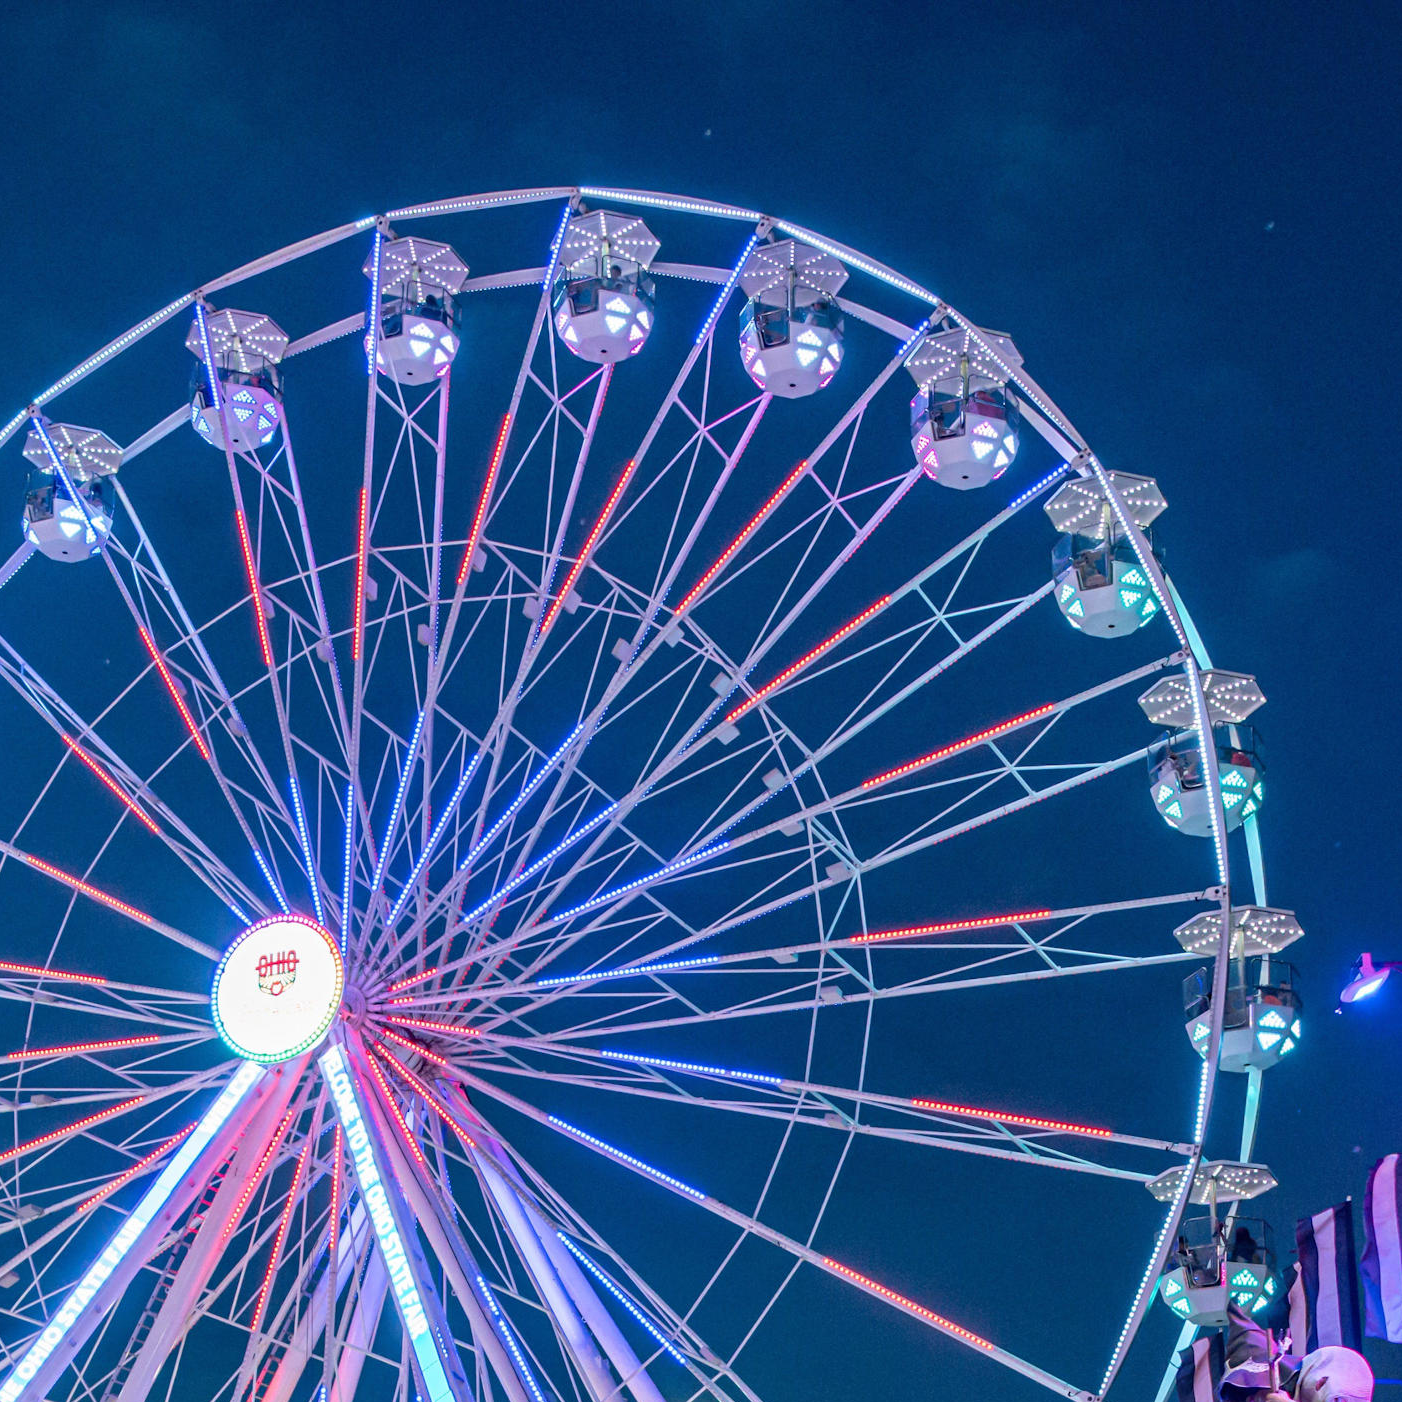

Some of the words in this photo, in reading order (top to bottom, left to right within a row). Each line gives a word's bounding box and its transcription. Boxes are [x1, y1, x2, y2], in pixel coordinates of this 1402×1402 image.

[257, 949, 298, 978] OHIO
[366, 1185, 395, 1237] OHIO
[381, 1232, 415, 1298] STATE
[16, 1326, 63, 1381] OHIO
